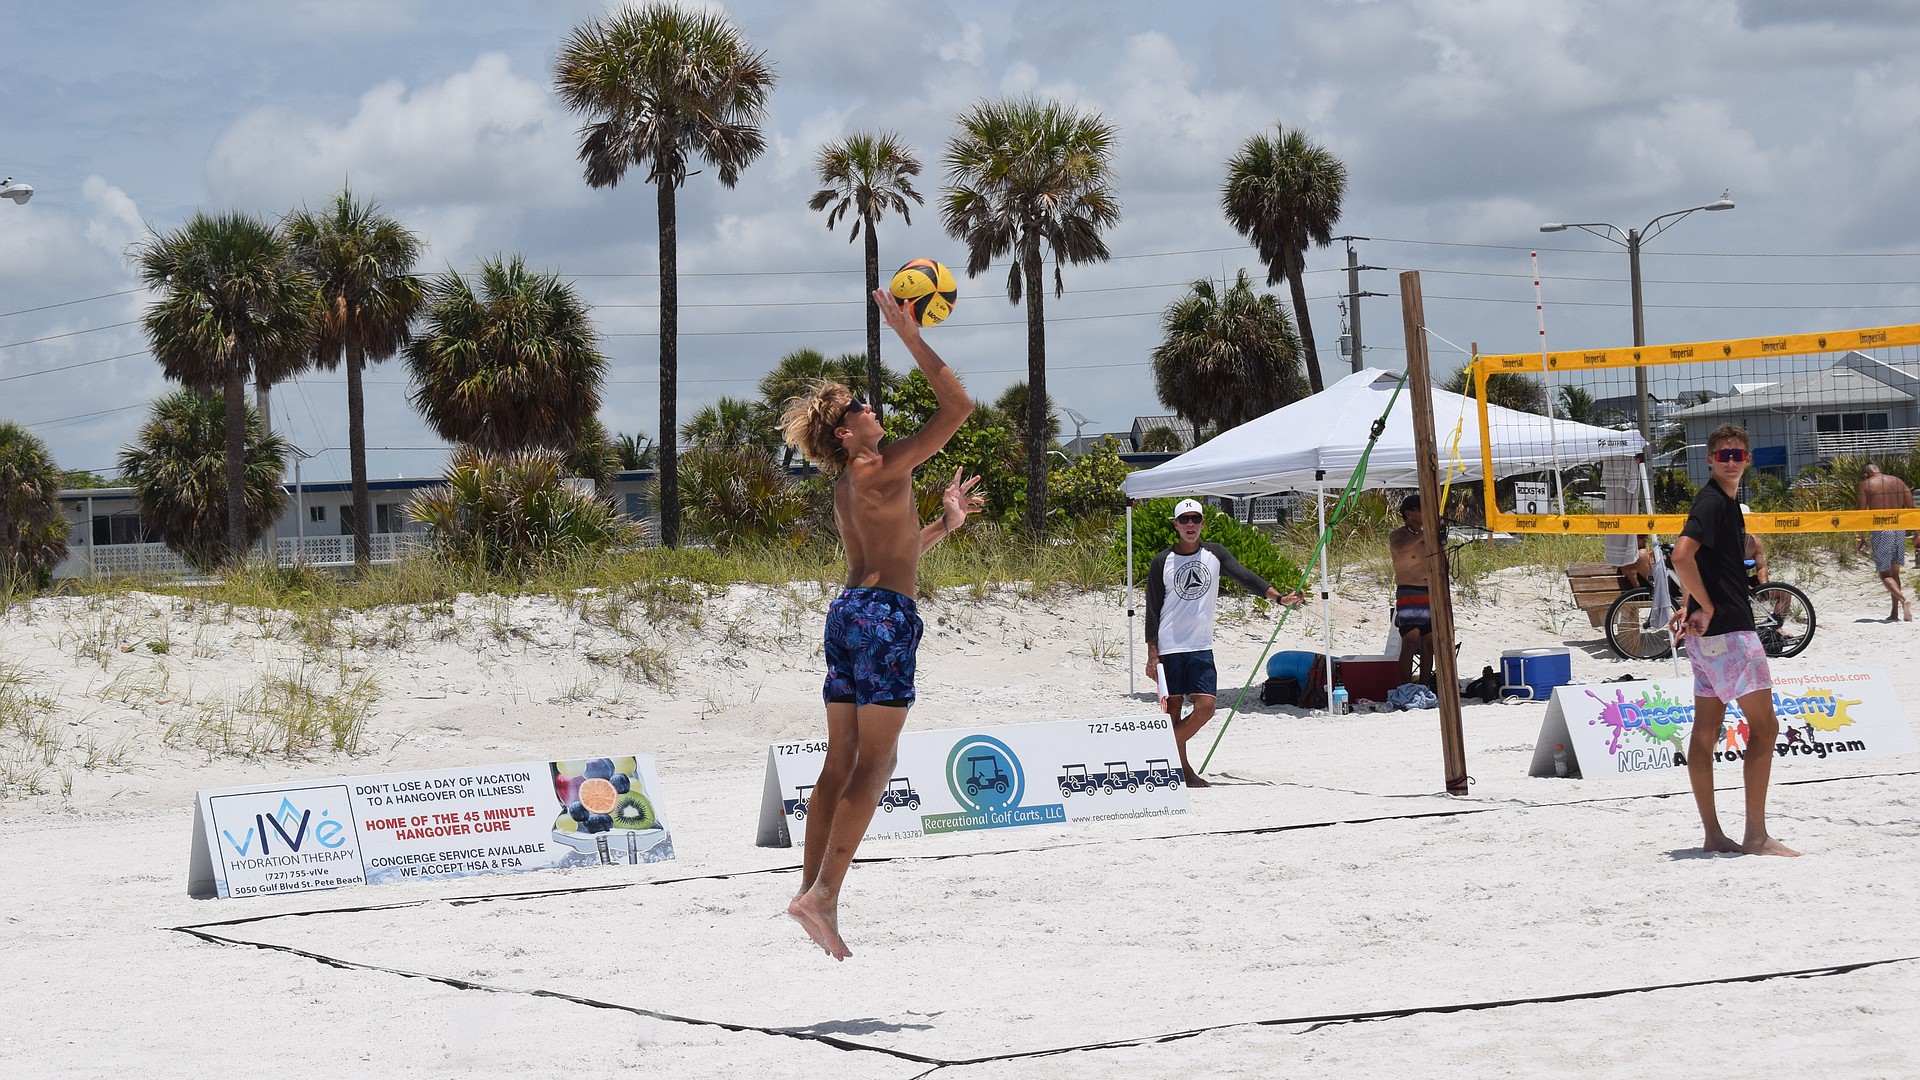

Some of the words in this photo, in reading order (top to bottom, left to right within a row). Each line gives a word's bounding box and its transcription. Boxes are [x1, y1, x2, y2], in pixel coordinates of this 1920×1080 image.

[1859, 331, 1886, 345] Imperial
[1761, 339, 1787, 352] Imperial
[1583, 353, 1606, 365] Imperial
[1670, 347, 1694, 360] Imperial
[1502, 358, 1524, 369] Imperial
[1516, 517, 1537, 529] Imperial
[1597, 518, 1620, 530] Imperial
[1774, 516, 1800, 530] Imperial
[1872, 514, 1899, 527] Imperial
[1771, 673, 1871, 686] demySchools.com
[1725, 692, 1836, 718] Ademy
[1088, 719, 1168, 734] 727-548-8460
[777, 742, 828, 755] 727-548
[1618, 747, 1671, 772] NCAA
[1776, 740, 1866, 759] Program
[355, 783, 390, 795] DON'T
[392, 781, 421, 792] LOSE
[424, 780, 432, 790] A
[434, 778, 456, 789] DAY
[459, 777, 473, 786] OF
[475, 772, 531, 785] VACATION
[366, 797, 382, 806] TO
[385, 796, 393, 805] A
[396, 790, 457, 804] HANGOVER
[459, 789, 475, 798] OR
[477, 785, 524, 797] ILLNESS!
[365, 817, 407, 831] HOME
[411, 815, 428, 827] OF
[432, 813, 460, 824] THE
[463, 811, 480, 822] 45
[483, 806, 536, 820] MINUTE
[925, 813, 989, 830] Recreational
[991, 810, 1012, 824] Golf
[1013, 809, 1043, 822] Carts,
[1045, 807, 1063, 819] LLC
[396, 824, 471, 840] HANGOVER
[474, 820, 511, 833] CURE
[231, 855, 300, 870] HYDRATION
[301, 850, 354, 864] THERAPY
[371, 853, 437, 868] CONCIERGE
[439, 849, 485, 860] SERVICE
[487, 843, 546, 857] AVAILABLE
[399, 867, 418, 877] WE
[420, 862, 463, 875] ACCEPT
[466, 860, 488, 871] HSA
[491, 859, 499, 868] &
[501, 857, 522, 868] FSA
[265, 871, 288, 881] (727)
[290, 868, 329, 878] 755-vIVe
[235, 886, 257, 894] 5050
[259, 884, 278, 893] Gulf
[280, 882, 299, 890] Blvd
[301, 880, 313, 888] St.
[315, 878, 335, 886] Pete
[336, 875, 363, 885] Beach
